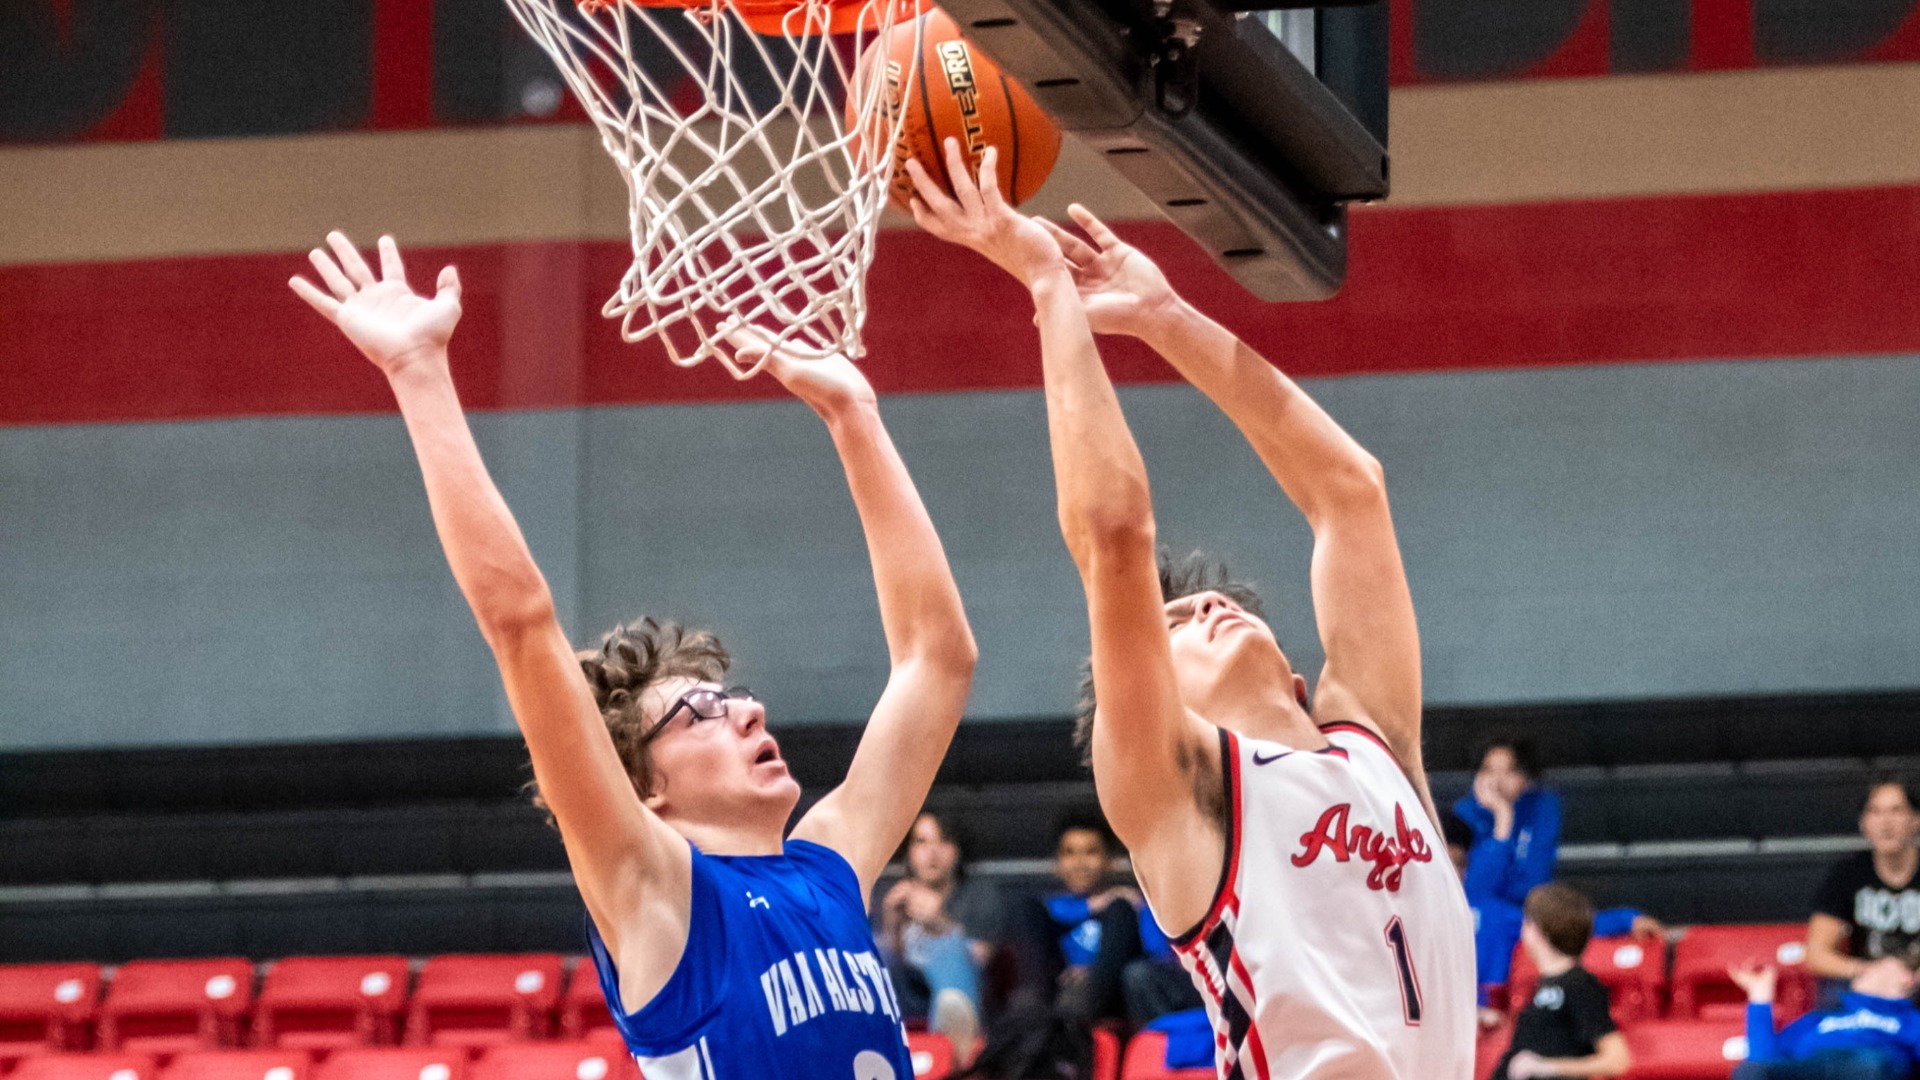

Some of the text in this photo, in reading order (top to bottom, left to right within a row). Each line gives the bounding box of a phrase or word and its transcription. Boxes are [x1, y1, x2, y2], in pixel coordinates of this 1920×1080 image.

[940, 41, 975, 90] PRO
[1290, 801, 1433, 892] Argyle
[814, 947, 909, 1047] ALST
[1384, 914, 1423, 1027] 1
